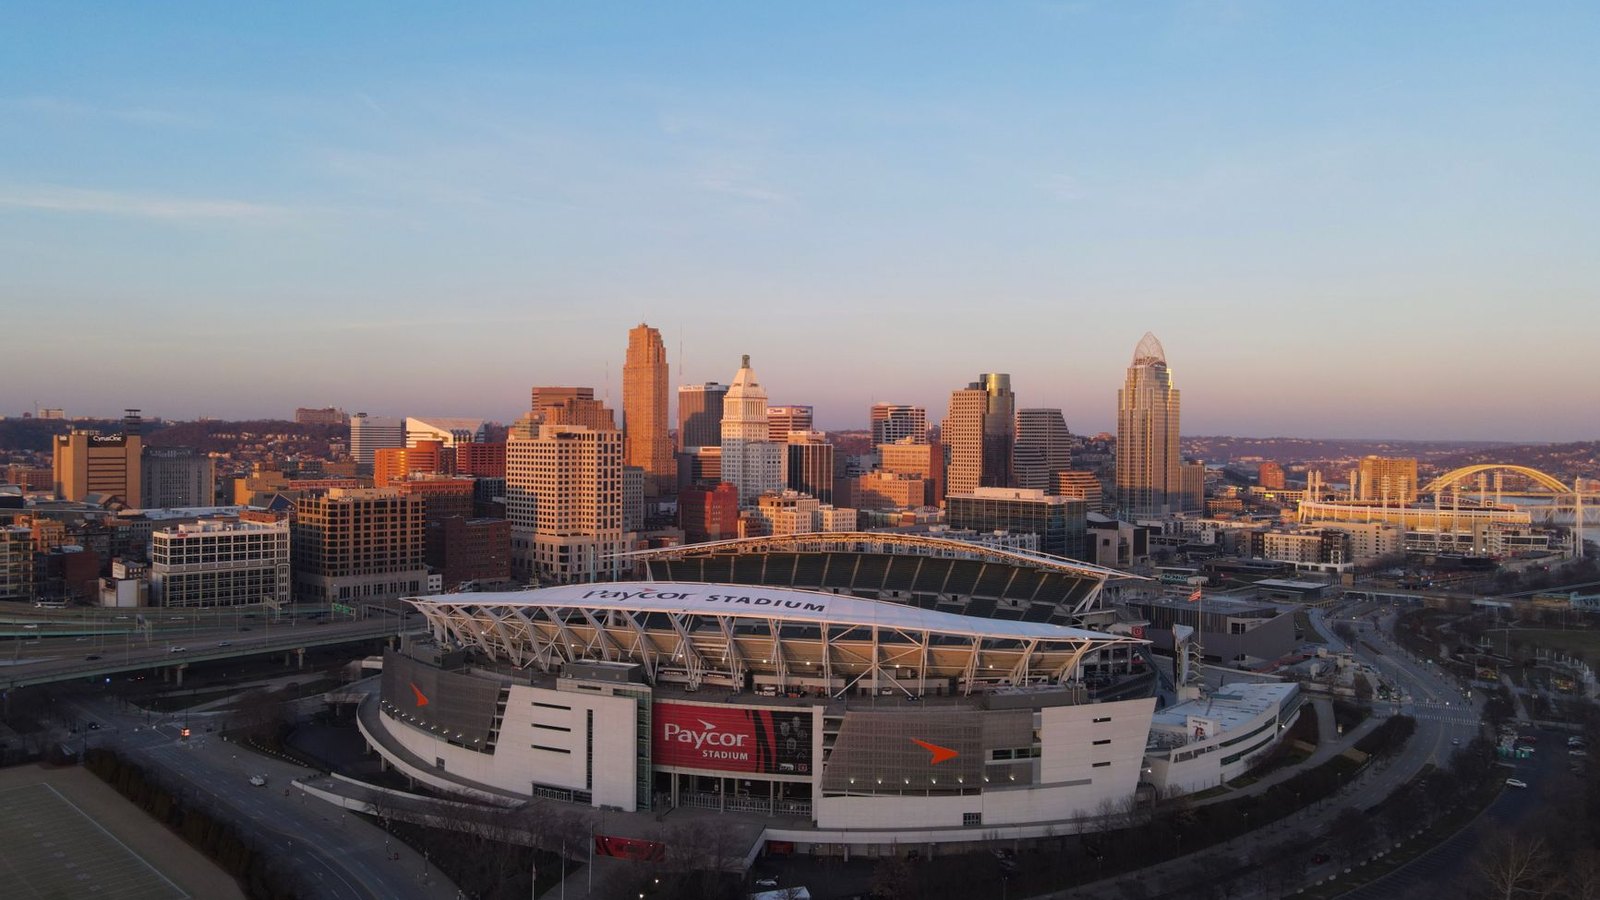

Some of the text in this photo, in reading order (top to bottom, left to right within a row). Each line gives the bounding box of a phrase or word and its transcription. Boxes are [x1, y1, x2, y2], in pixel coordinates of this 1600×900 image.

[583, 590, 825, 612] Paycor STADIUM
[664, 723, 749, 749] Paycor
[702, 750, 748, 761] STADIUM
